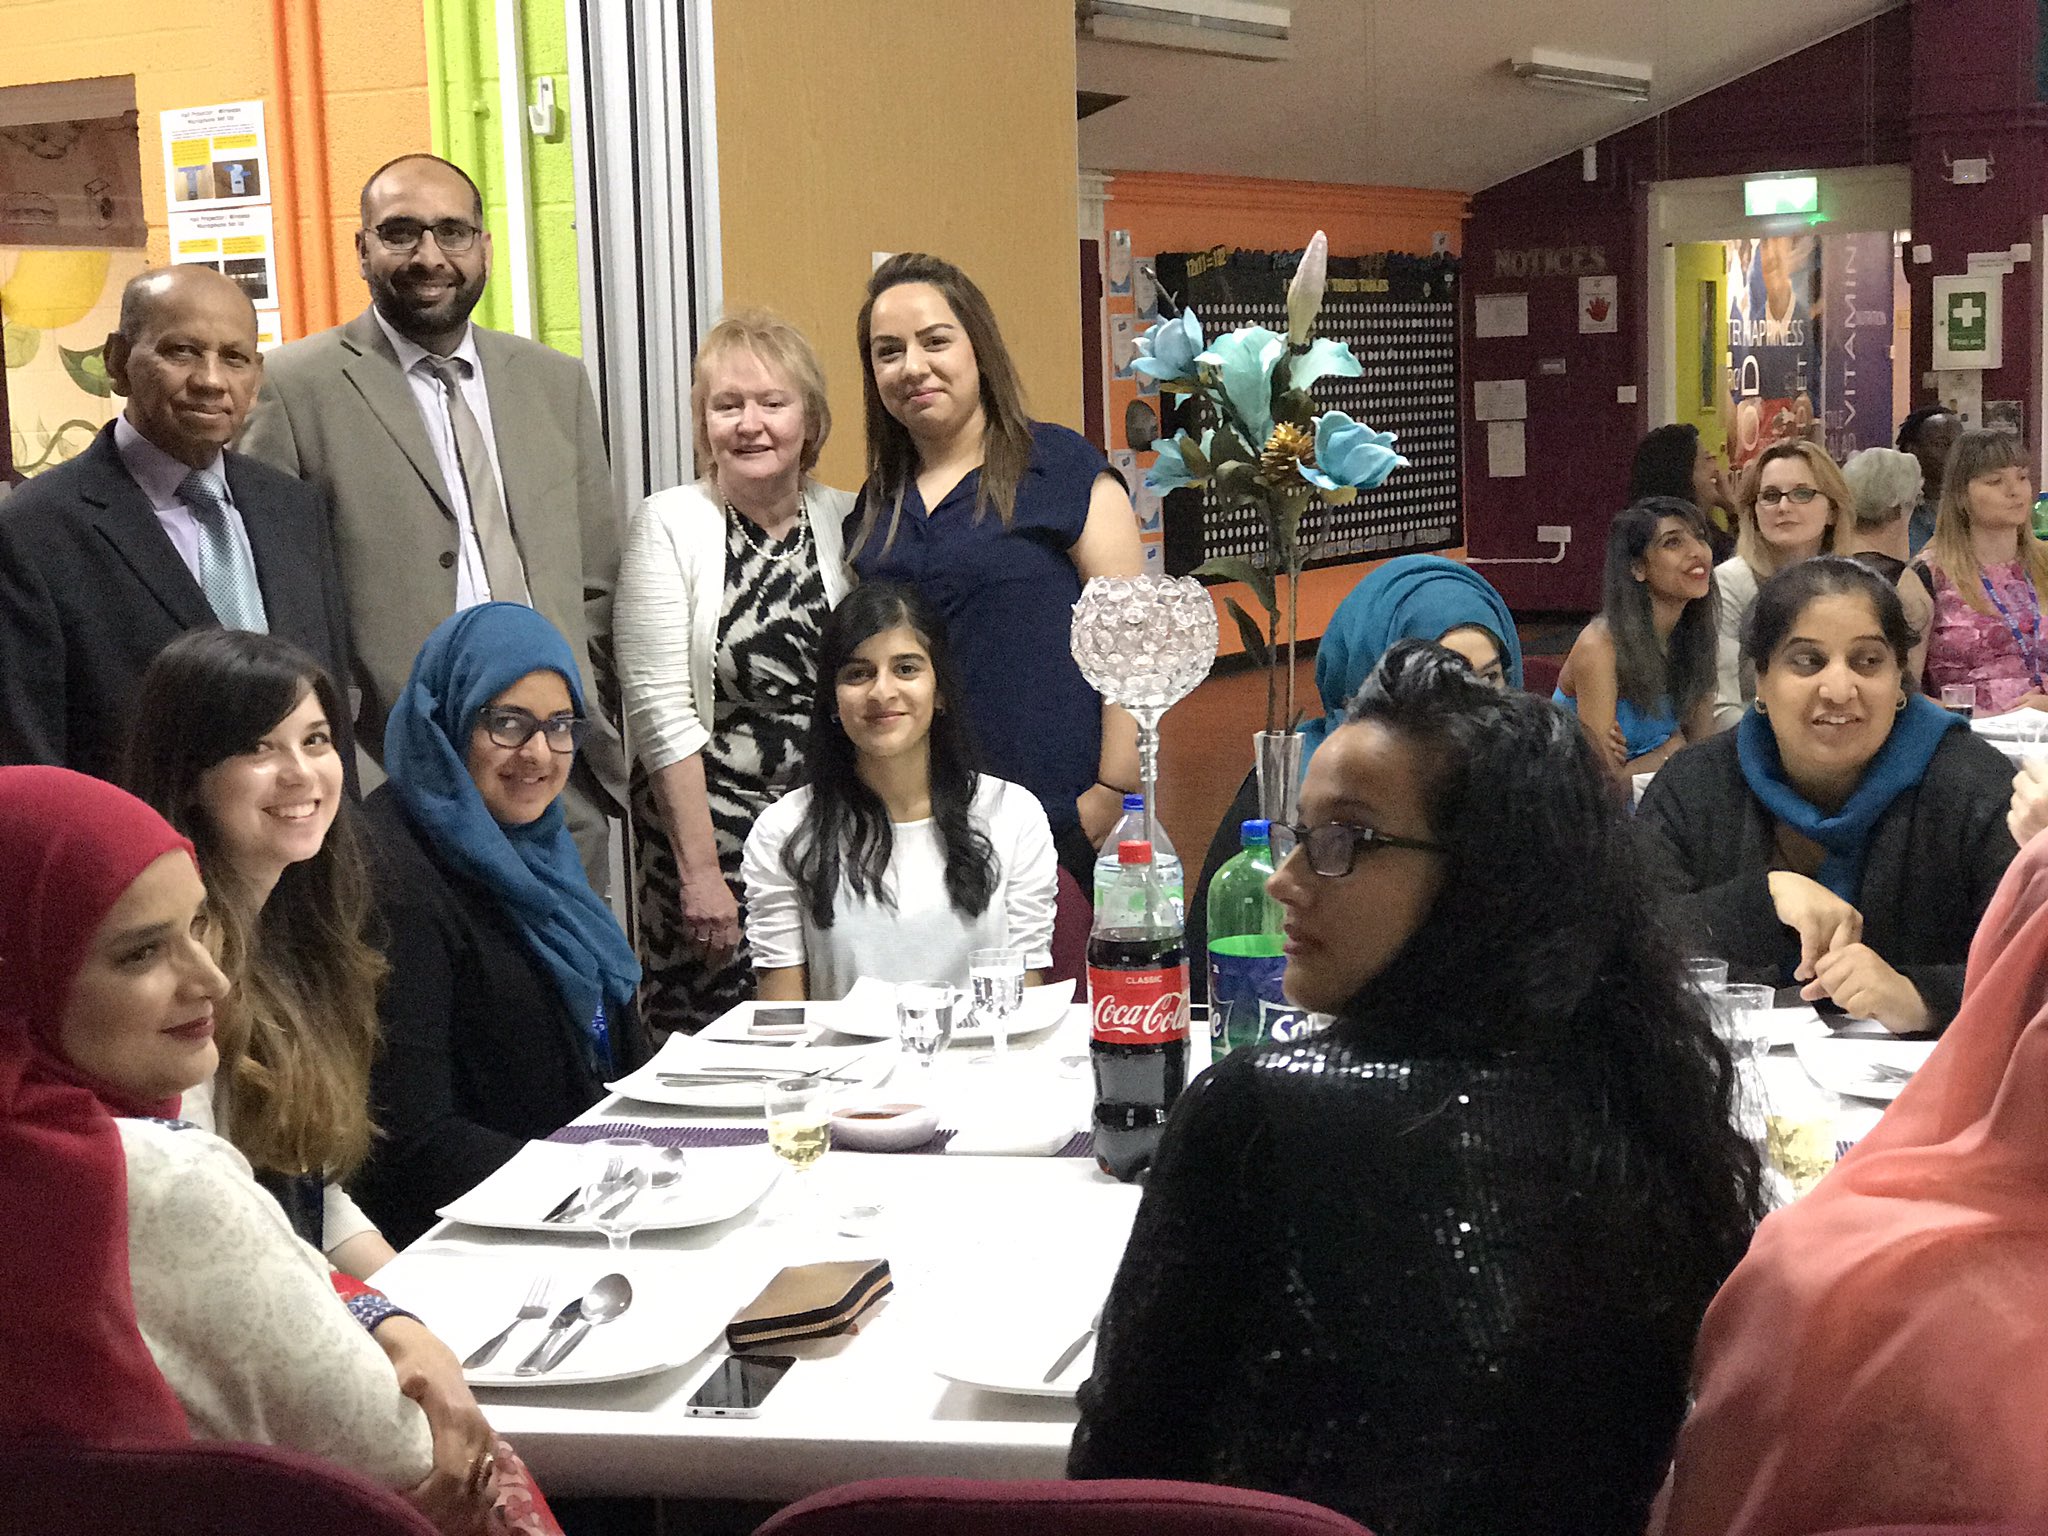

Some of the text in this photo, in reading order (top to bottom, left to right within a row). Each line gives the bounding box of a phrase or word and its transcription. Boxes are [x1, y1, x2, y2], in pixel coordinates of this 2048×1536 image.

[1495, 246, 1607, 277] NOTICES
[1743, 319, 1805, 346] HAPPINESS
[1844, 235, 1857, 426] VITAMIN
[1125, 975, 1163, 985] CLASSIC
